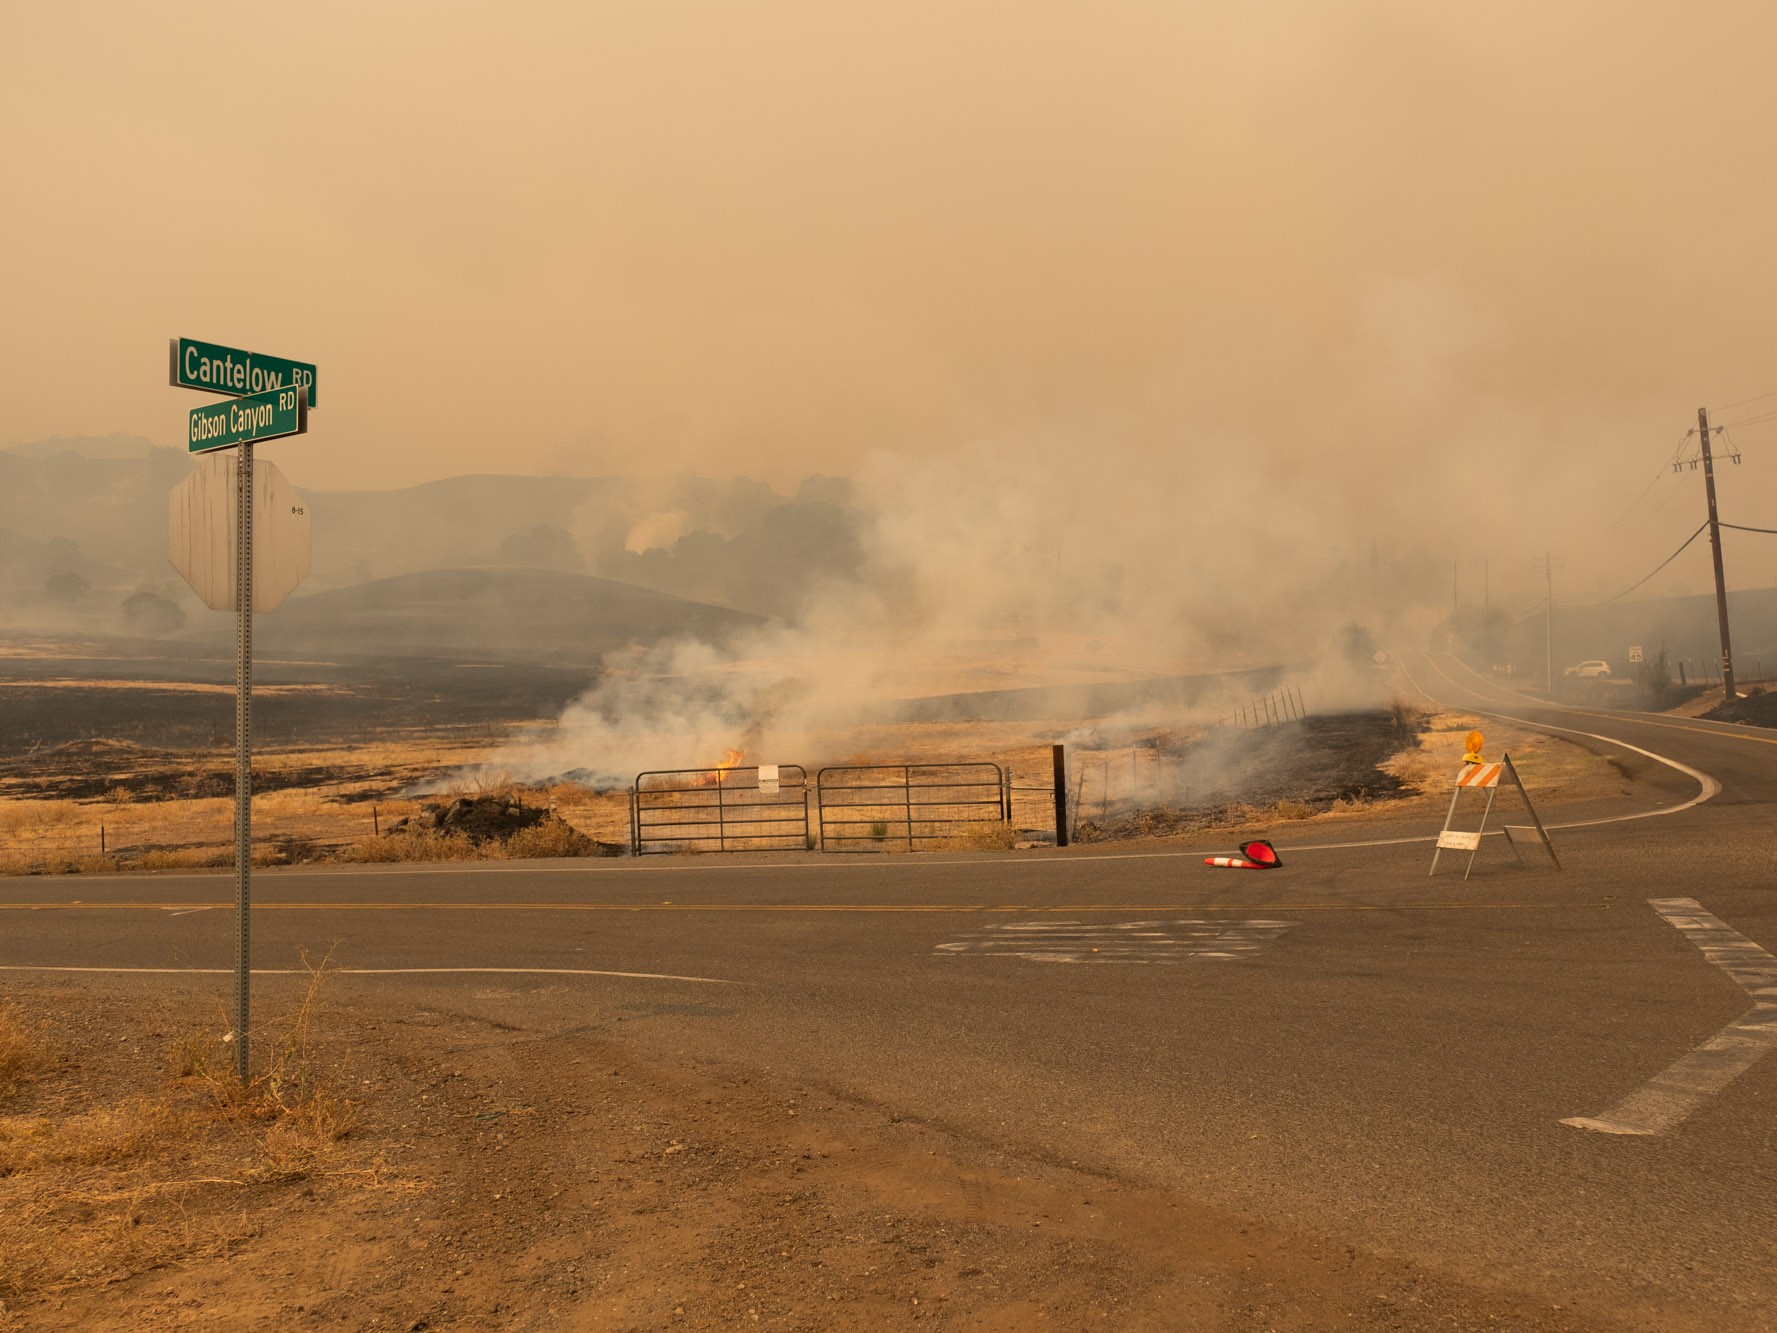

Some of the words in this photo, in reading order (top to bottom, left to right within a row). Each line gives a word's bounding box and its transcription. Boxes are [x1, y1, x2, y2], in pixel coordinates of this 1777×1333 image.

[185, 346, 282, 392] Cantelow
[293, 367, 312, 387] RD
[191, 412, 226, 442] Gibson
[230, 404, 273, 436] Canyon
[279, 391, 295, 411] RD
[291, 506, 304, 515] 8-15
